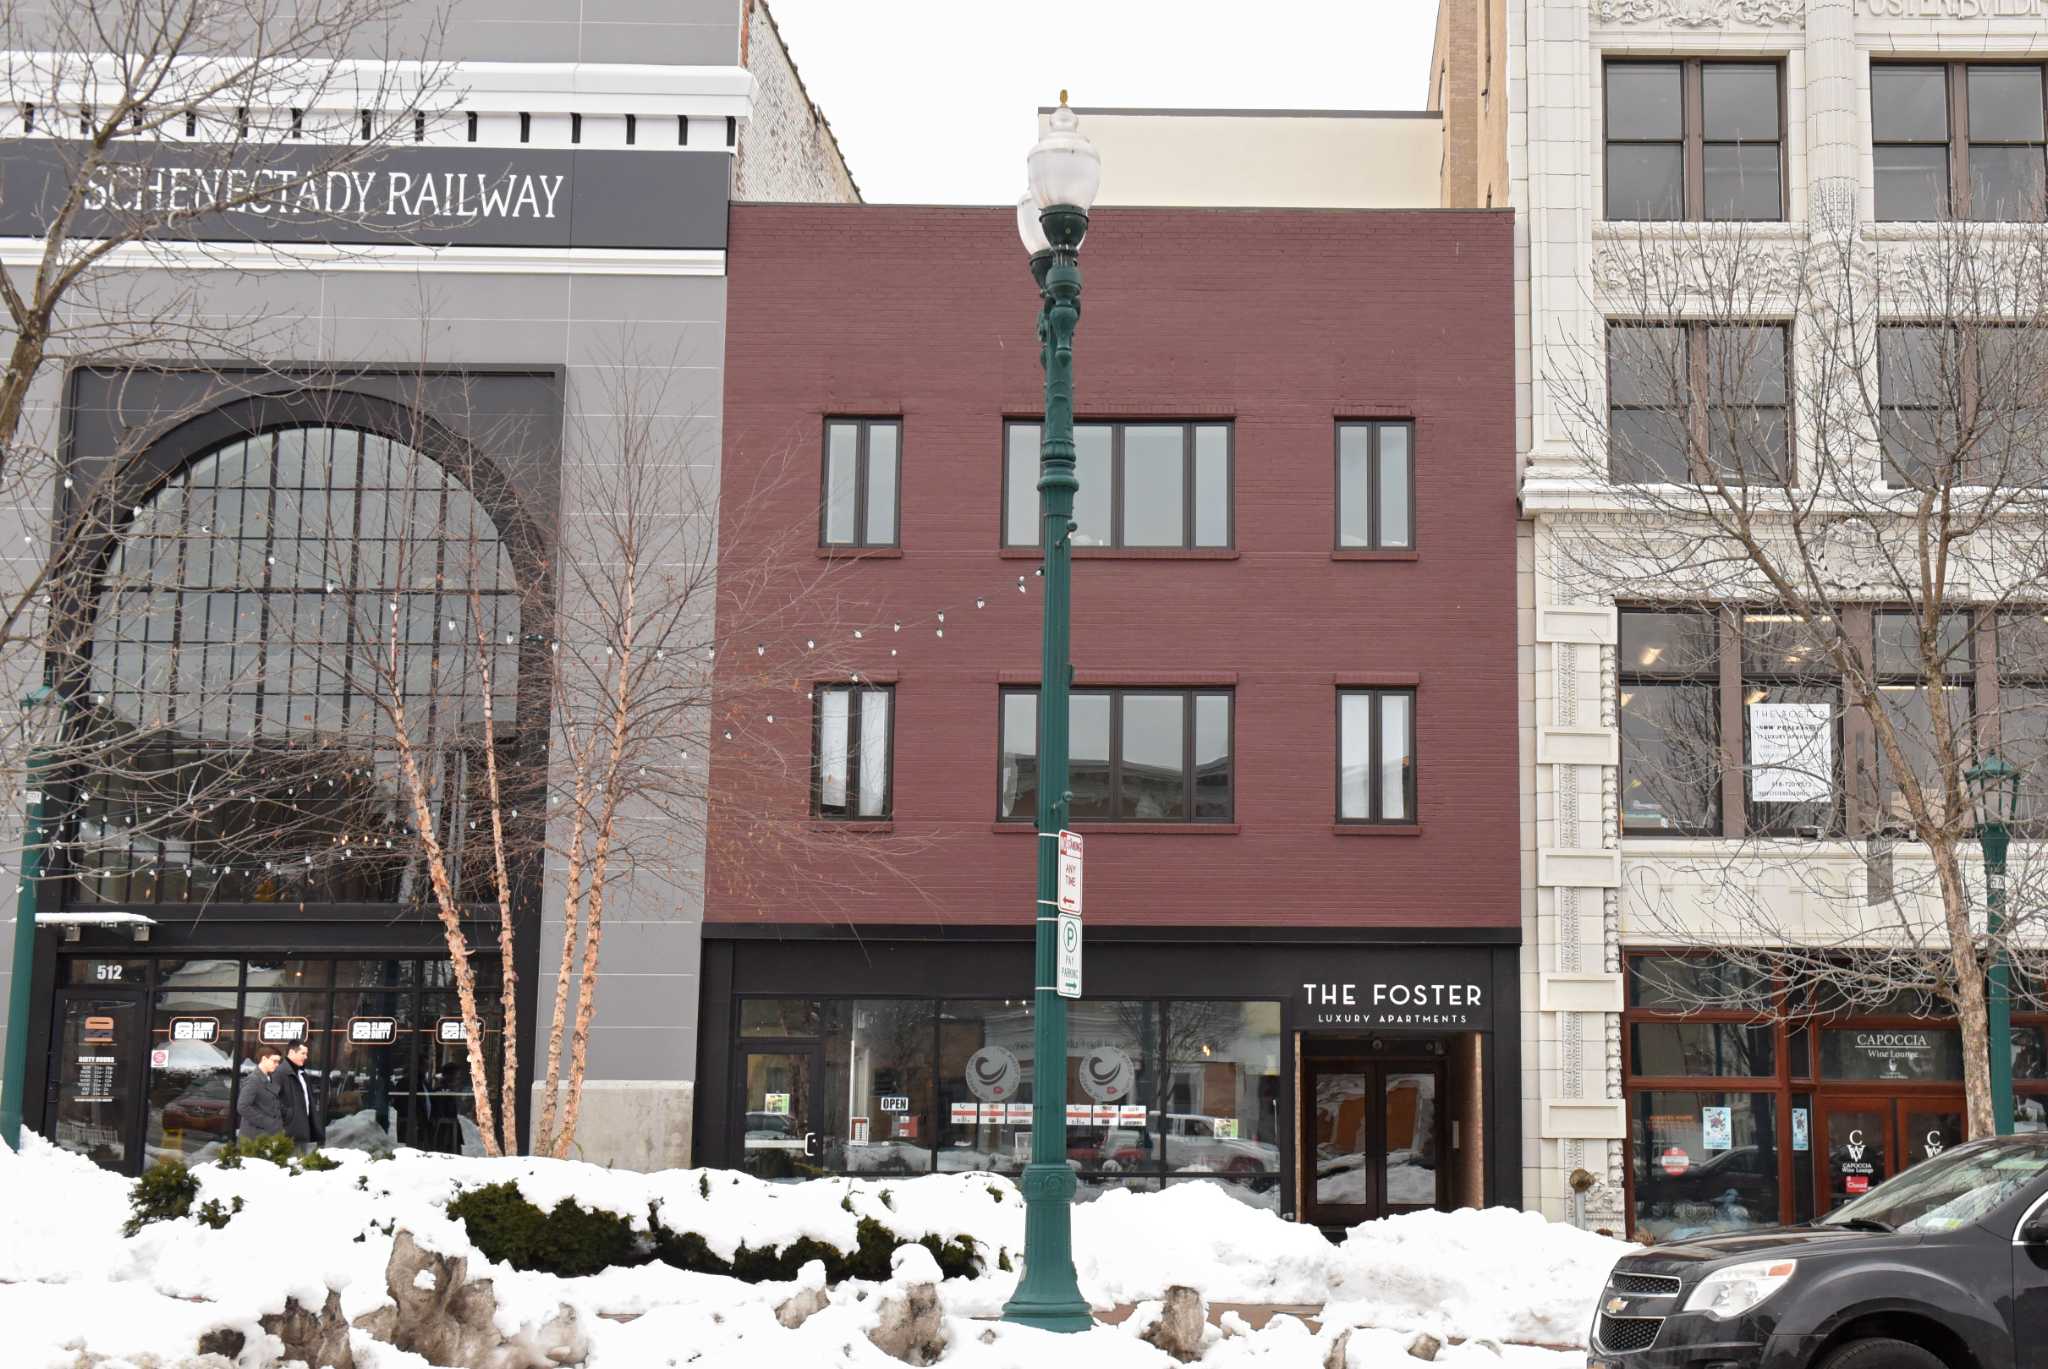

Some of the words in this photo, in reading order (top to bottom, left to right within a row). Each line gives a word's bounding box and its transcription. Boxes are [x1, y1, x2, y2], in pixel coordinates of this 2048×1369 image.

[84, 165, 376, 214] SCHENECTADY
[387, 172, 564, 218] RAILWAY
[1066, 863, 1076, 875] ANY
[97, 965, 122, 980] 512
[1062, 967, 1079, 980] PARKING
[1303, 983, 1356, 1005] THE
[1373, 984, 1481, 1006] FOSTER
[1318, 1014, 1370, 1023] LUXURY
[1379, 1014, 1467, 1024] APARTMENTS
[1857, 1034, 1927, 1046] CAPOCCIA
[1868, 1049, 1888, 1058] Wine
[882, 1098, 907, 1109] OPEN
